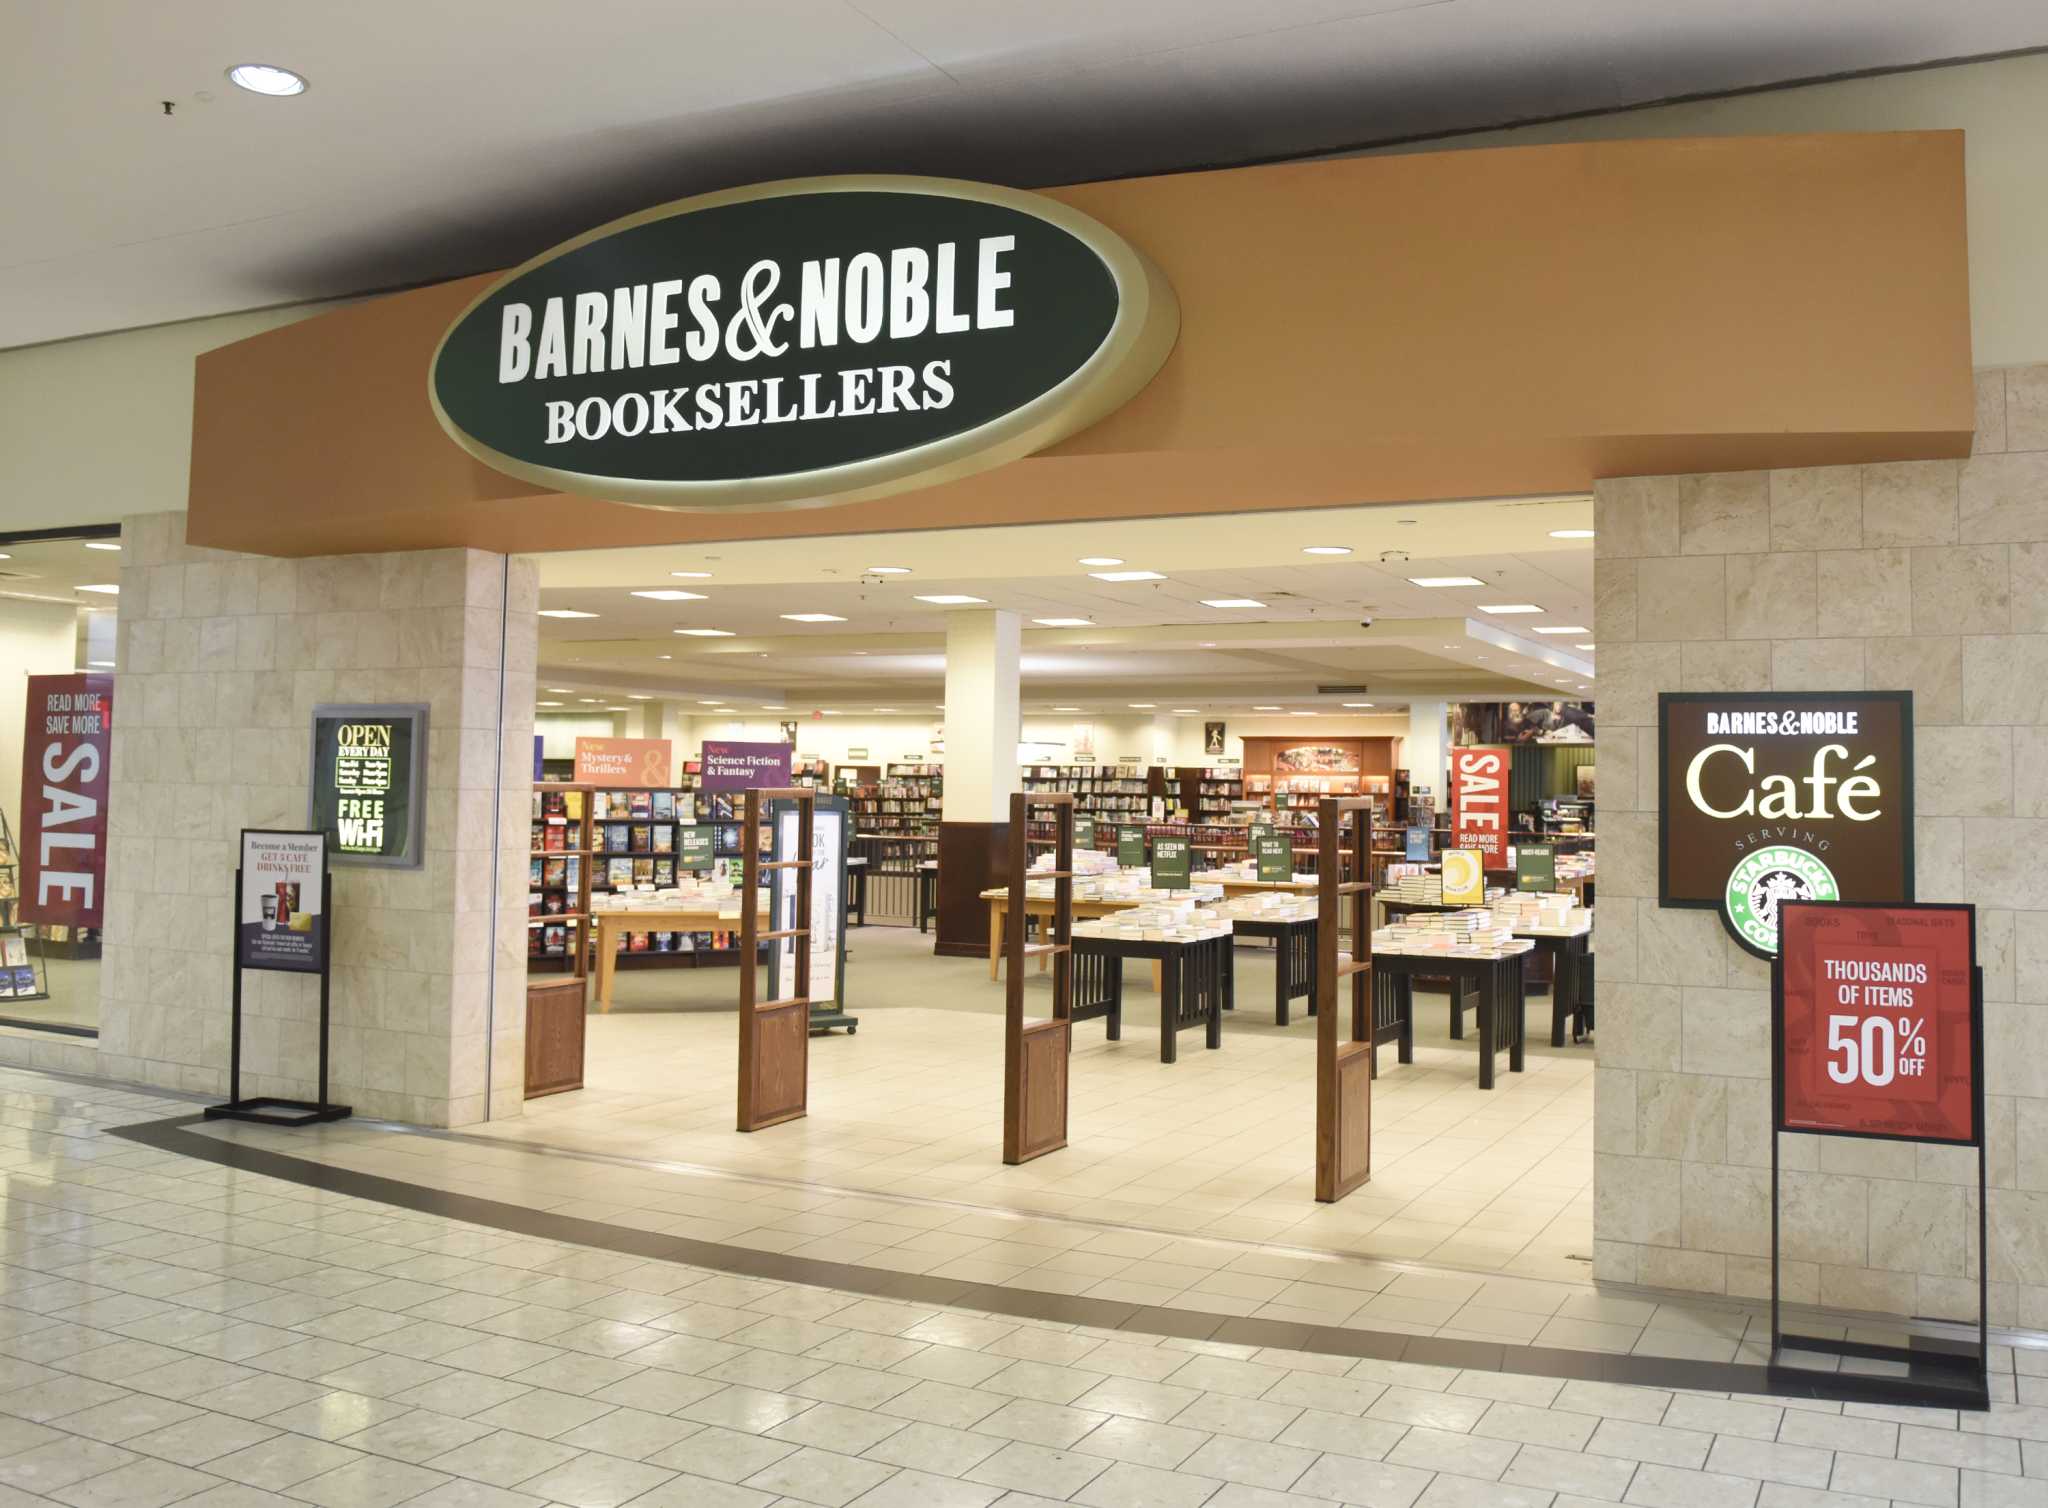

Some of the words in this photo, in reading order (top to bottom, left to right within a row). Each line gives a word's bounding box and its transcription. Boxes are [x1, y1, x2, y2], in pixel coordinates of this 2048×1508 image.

[544, 360, 954, 444] BOOKSELLERS
[48, 694, 71, 711] READ
[75, 693, 101, 711] MORE
[47, 715, 70, 734] SAVE
[72, 715, 100, 734] MORE
[337, 725, 392, 746] OPEN
[338, 746, 370, 756] EVERY
[371, 747, 390, 757] DAY
[582, 752, 622, 764] Mystery
[707, 755, 745, 765] Science
[747, 756, 780, 766] Fiction
[582, 763, 626, 774] Thrillers
[707, 766, 716, 776] &
[718, 766, 755, 778] Fantasy
[1686, 743, 1881, 821] Café
[1459, 754, 1500, 830] SALE
[338, 799, 384, 818] FREE
[38, 742, 100, 909] SALE
[1460, 833, 1478, 843] READ
[1479, 834, 1499, 843] MORE
[1735, 826, 1830, 850] SERVING
[1732, 850, 1833, 896] STARBUCKS
[1824, 959, 1928, 984] THOUSANDS
[1838, 985, 1859, 1005] OF
[1864, 986, 1914, 1008] ITEMS
[1899, 1058, 1925, 1077] OFF
